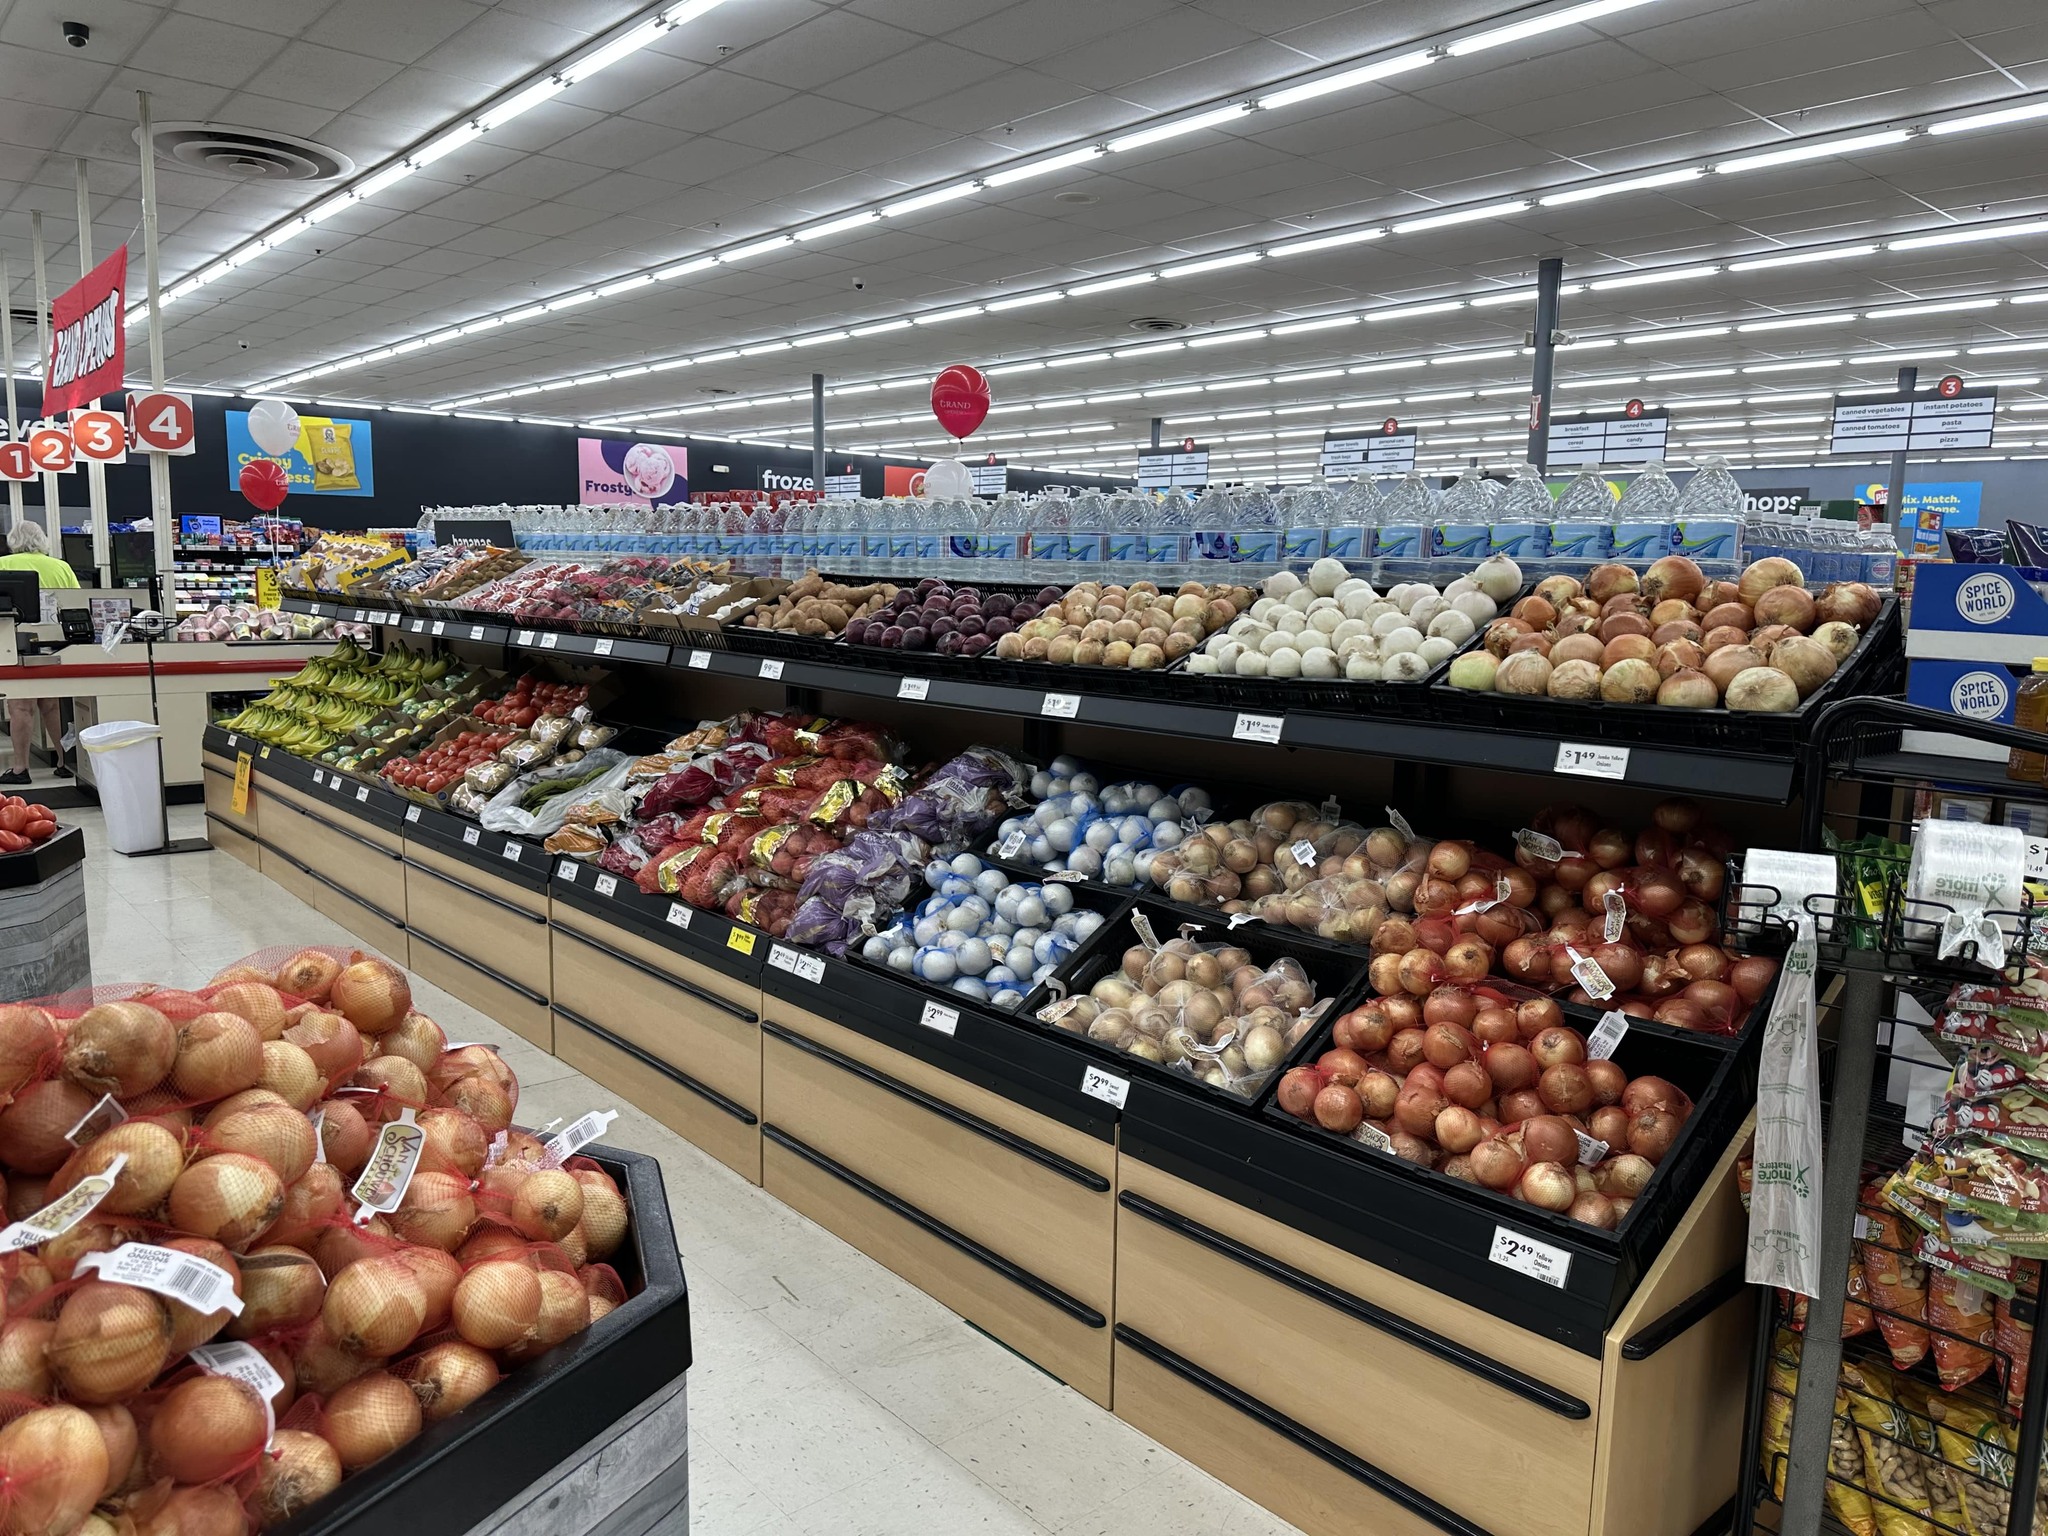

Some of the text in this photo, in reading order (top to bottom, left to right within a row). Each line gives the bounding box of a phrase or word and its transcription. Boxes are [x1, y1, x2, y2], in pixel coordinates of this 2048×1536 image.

[1945, 381, 1956, 394] 3
[940, 399, 971, 410] GRAND
[1630, 404, 1638, 415] 4
[1867, 406, 1905, 415] vegetables
[1923, 401, 1983, 411] instant potatoes
[129, 405, 136, 433] 4
[149, 405, 182, 440] 4
[1941, 419, 1962, 427] pasta
[1387, 422, 1393, 432] 5
[1841, 424, 1866, 432] canned
[87, 420, 113, 452] 3
[1626, 436, 1643, 444] candy
[1939, 436, 1958, 444] pizza
[42, 437, 65, 464] 2
[1186, 441, 1192, 450] 6
[9, 450, 23, 473] 1
[762, 469, 814, 491] froze
[1742, 490, 1803, 513] hops
[1922, 494, 1961, 504] Match.
[451, 535, 492, 547] bananas
[351, 556, 406, 579] ripe bananas
[1965, 581, 2002, 600] SPICE
[1965, 594, 2007, 613] WORLD
[1959, 680, 1995, 697] SPICE
[1959, 693, 2000, 711] WORLD
[396, 1134, 423, 1164] VAN
[363, 1131, 404, 1202] SCHOUWEN
[1758, 1162, 1791, 1170] matters
[1758, 1170, 1792, 1181] more
[20, 1229, 51, 1242] YELLO
[1764, 1229, 1800, 1241] OPEN HERE
[133, 1247, 172, 1258] YELLOW
[1500, 1236, 1553, 1264] $249 Yellow
[127, 1252, 170, 1263] ONIONS
[1534, 1259, 1550, 1271] Onions
[1984, 1268, 2007, 1280] APPLES
